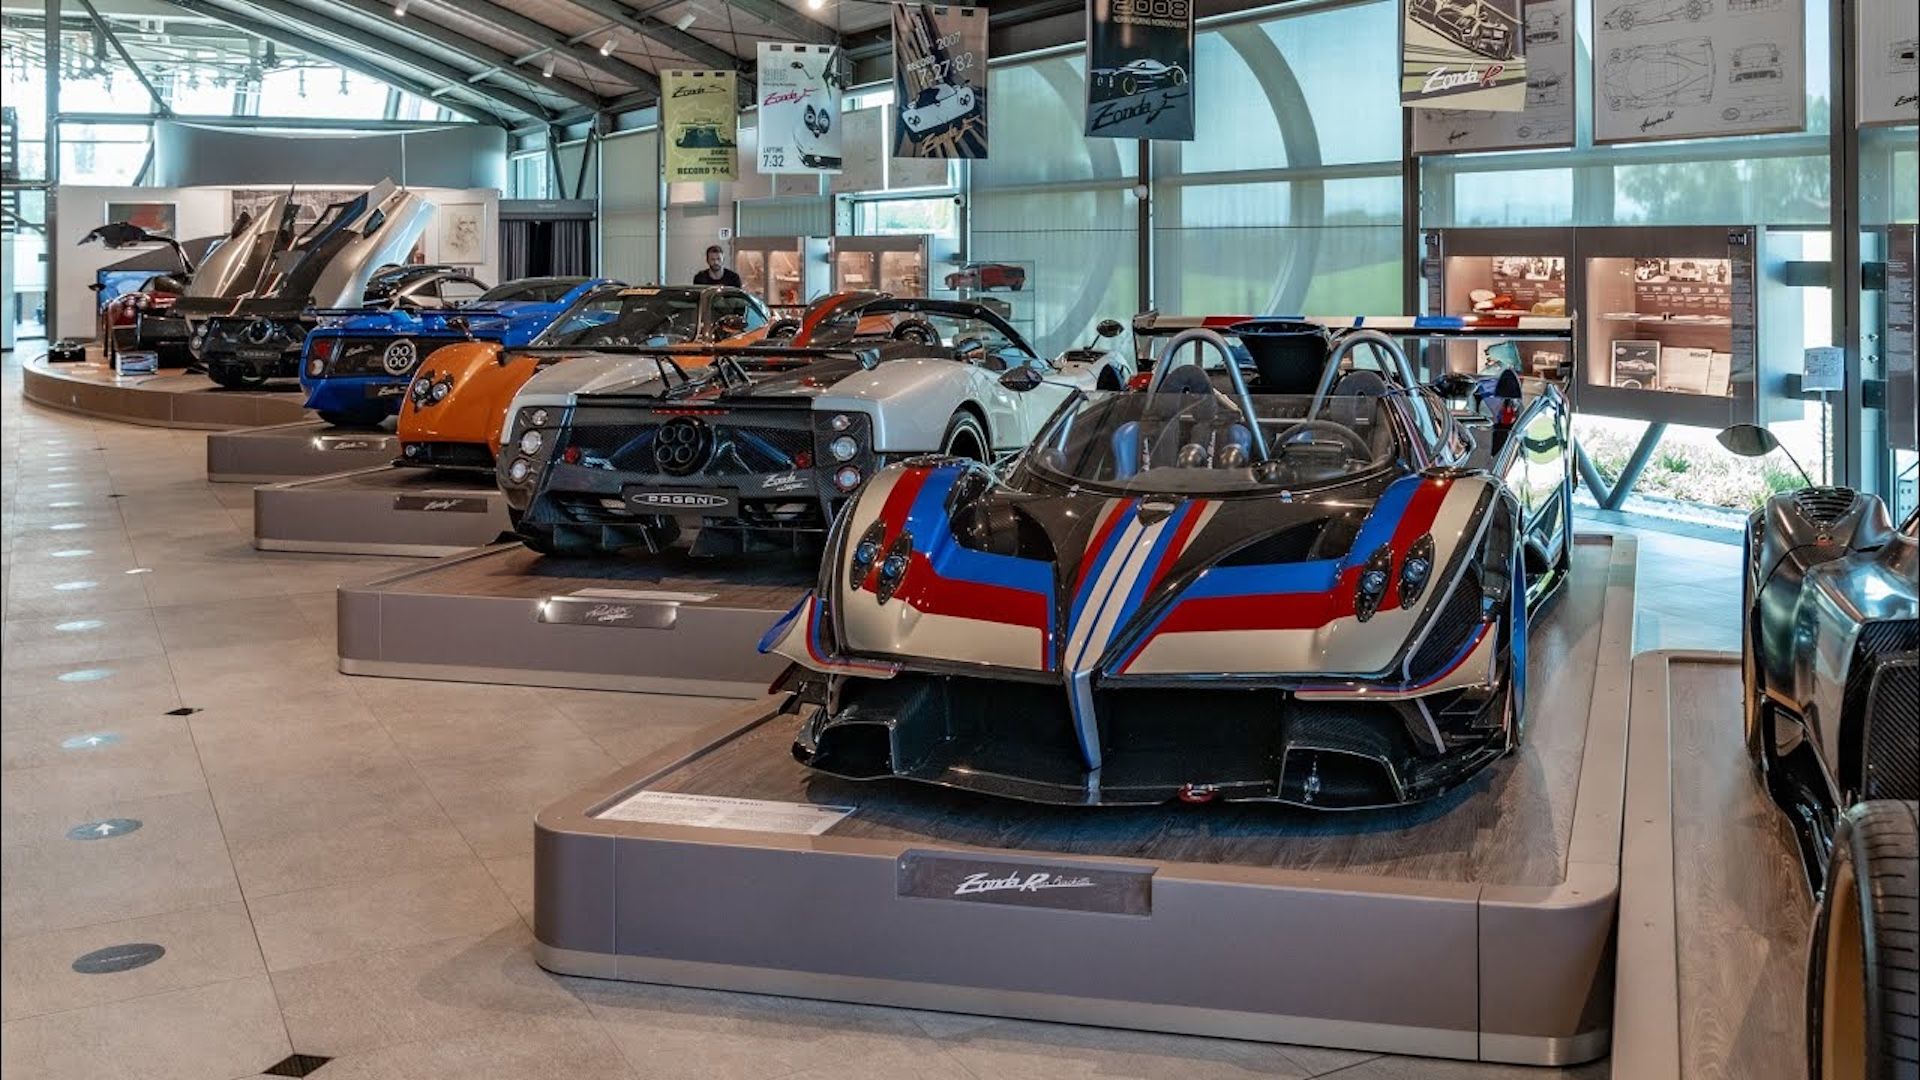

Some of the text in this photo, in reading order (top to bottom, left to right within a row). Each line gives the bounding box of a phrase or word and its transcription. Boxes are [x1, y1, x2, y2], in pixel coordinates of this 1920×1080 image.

[936, 31, 961, 50] 2007
[906, 55, 935, 71] RECORD
[1422, 62, 1505, 94] Zonda R
[1091, 95, 1152, 131] Zonda
[763, 155, 784, 167] 7:32
[649, 495, 713, 505] PAGANI
[954, 871, 1021, 895] Zonda
